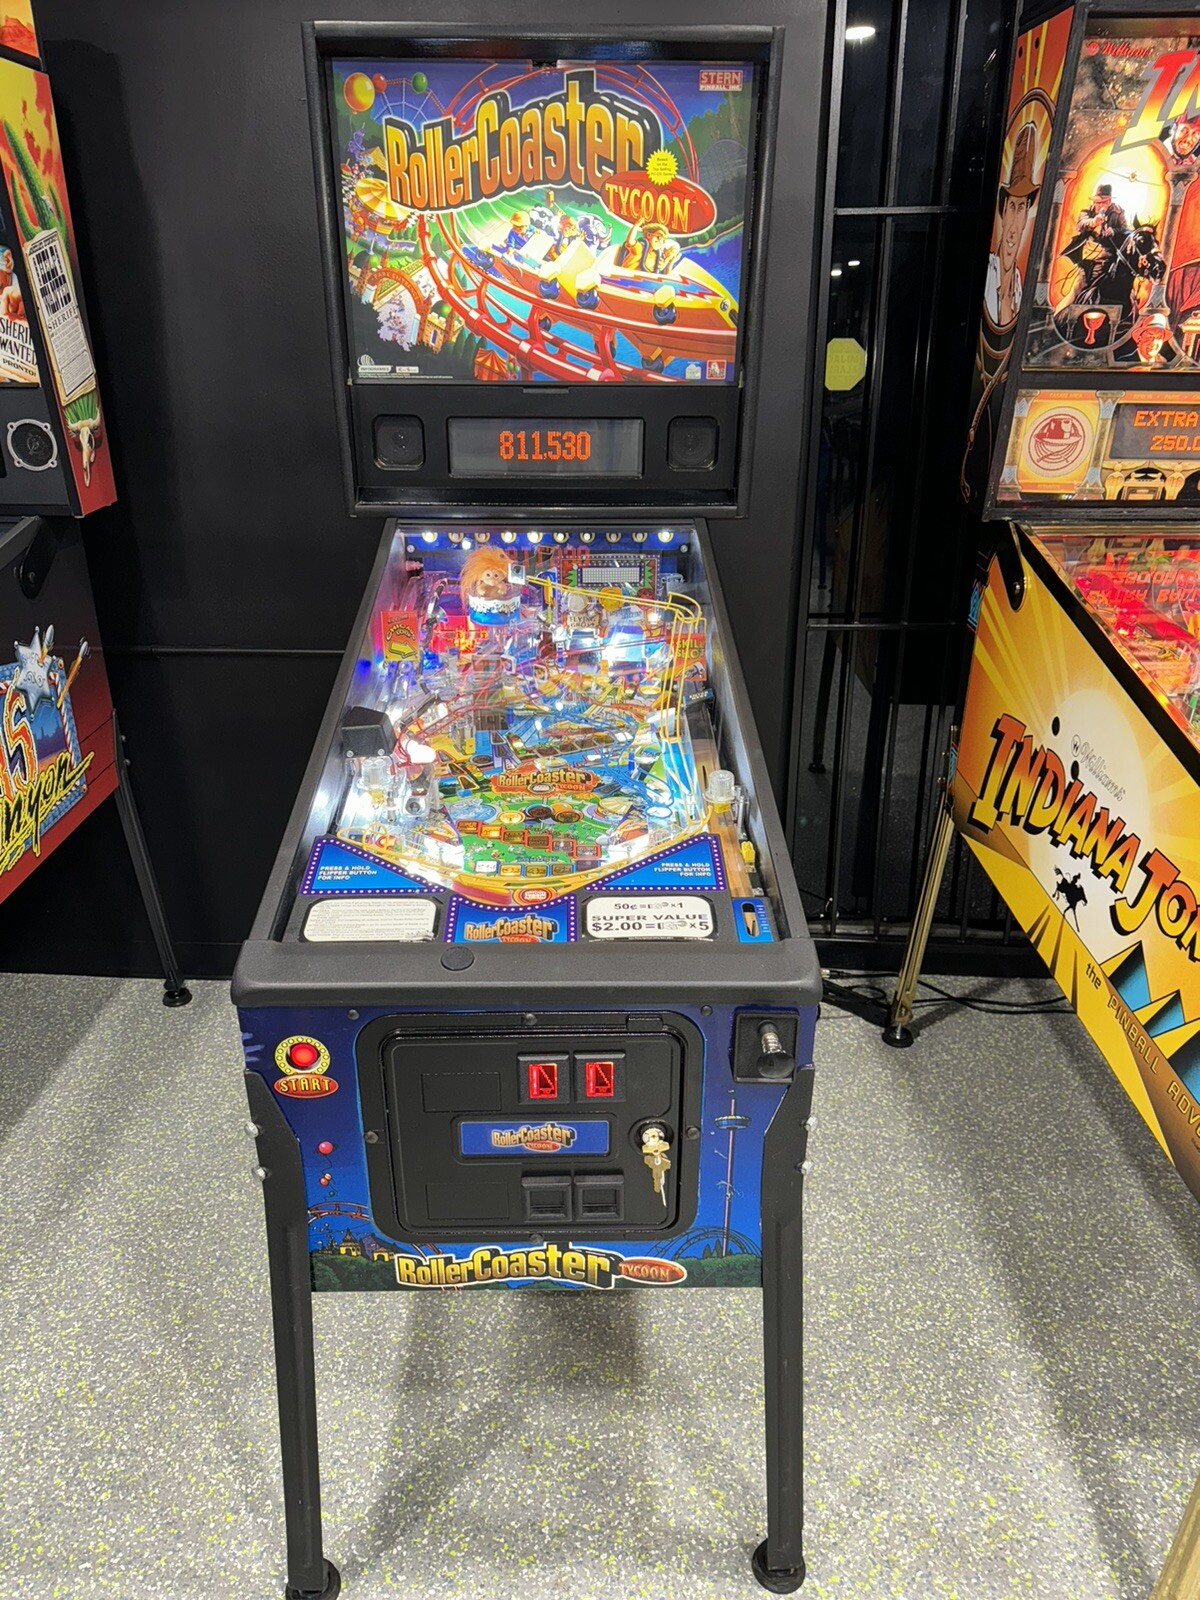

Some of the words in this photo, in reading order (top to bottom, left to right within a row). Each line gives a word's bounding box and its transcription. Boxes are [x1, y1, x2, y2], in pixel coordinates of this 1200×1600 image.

[701, 72, 741, 84] STERN
[386, 80, 644, 209] RollerCoaster
[605, 183, 690, 231] TYCOON
[48, 306, 77, 332] SHERIFF
[1134, 410, 1199, 427] EXTRA
[499, 768, 587, 785] RollerCoaster
[968, 713, 1142, 894] INDIANA
[465, 915, 553, 940] RollerCoaster
[1085, 962, 1102, 990] the
[1106, 994, 1160, 1076] PINBALL
[280, 1077, 331, 1092] START
[492, 1124, 573, 1147] RollerCoaster
[526, 1142, 554, 1150] TYCOON
[399, 1244, 610, 1287] RollerCoaster
[619, 1263, 669, 1280] TYCOON
